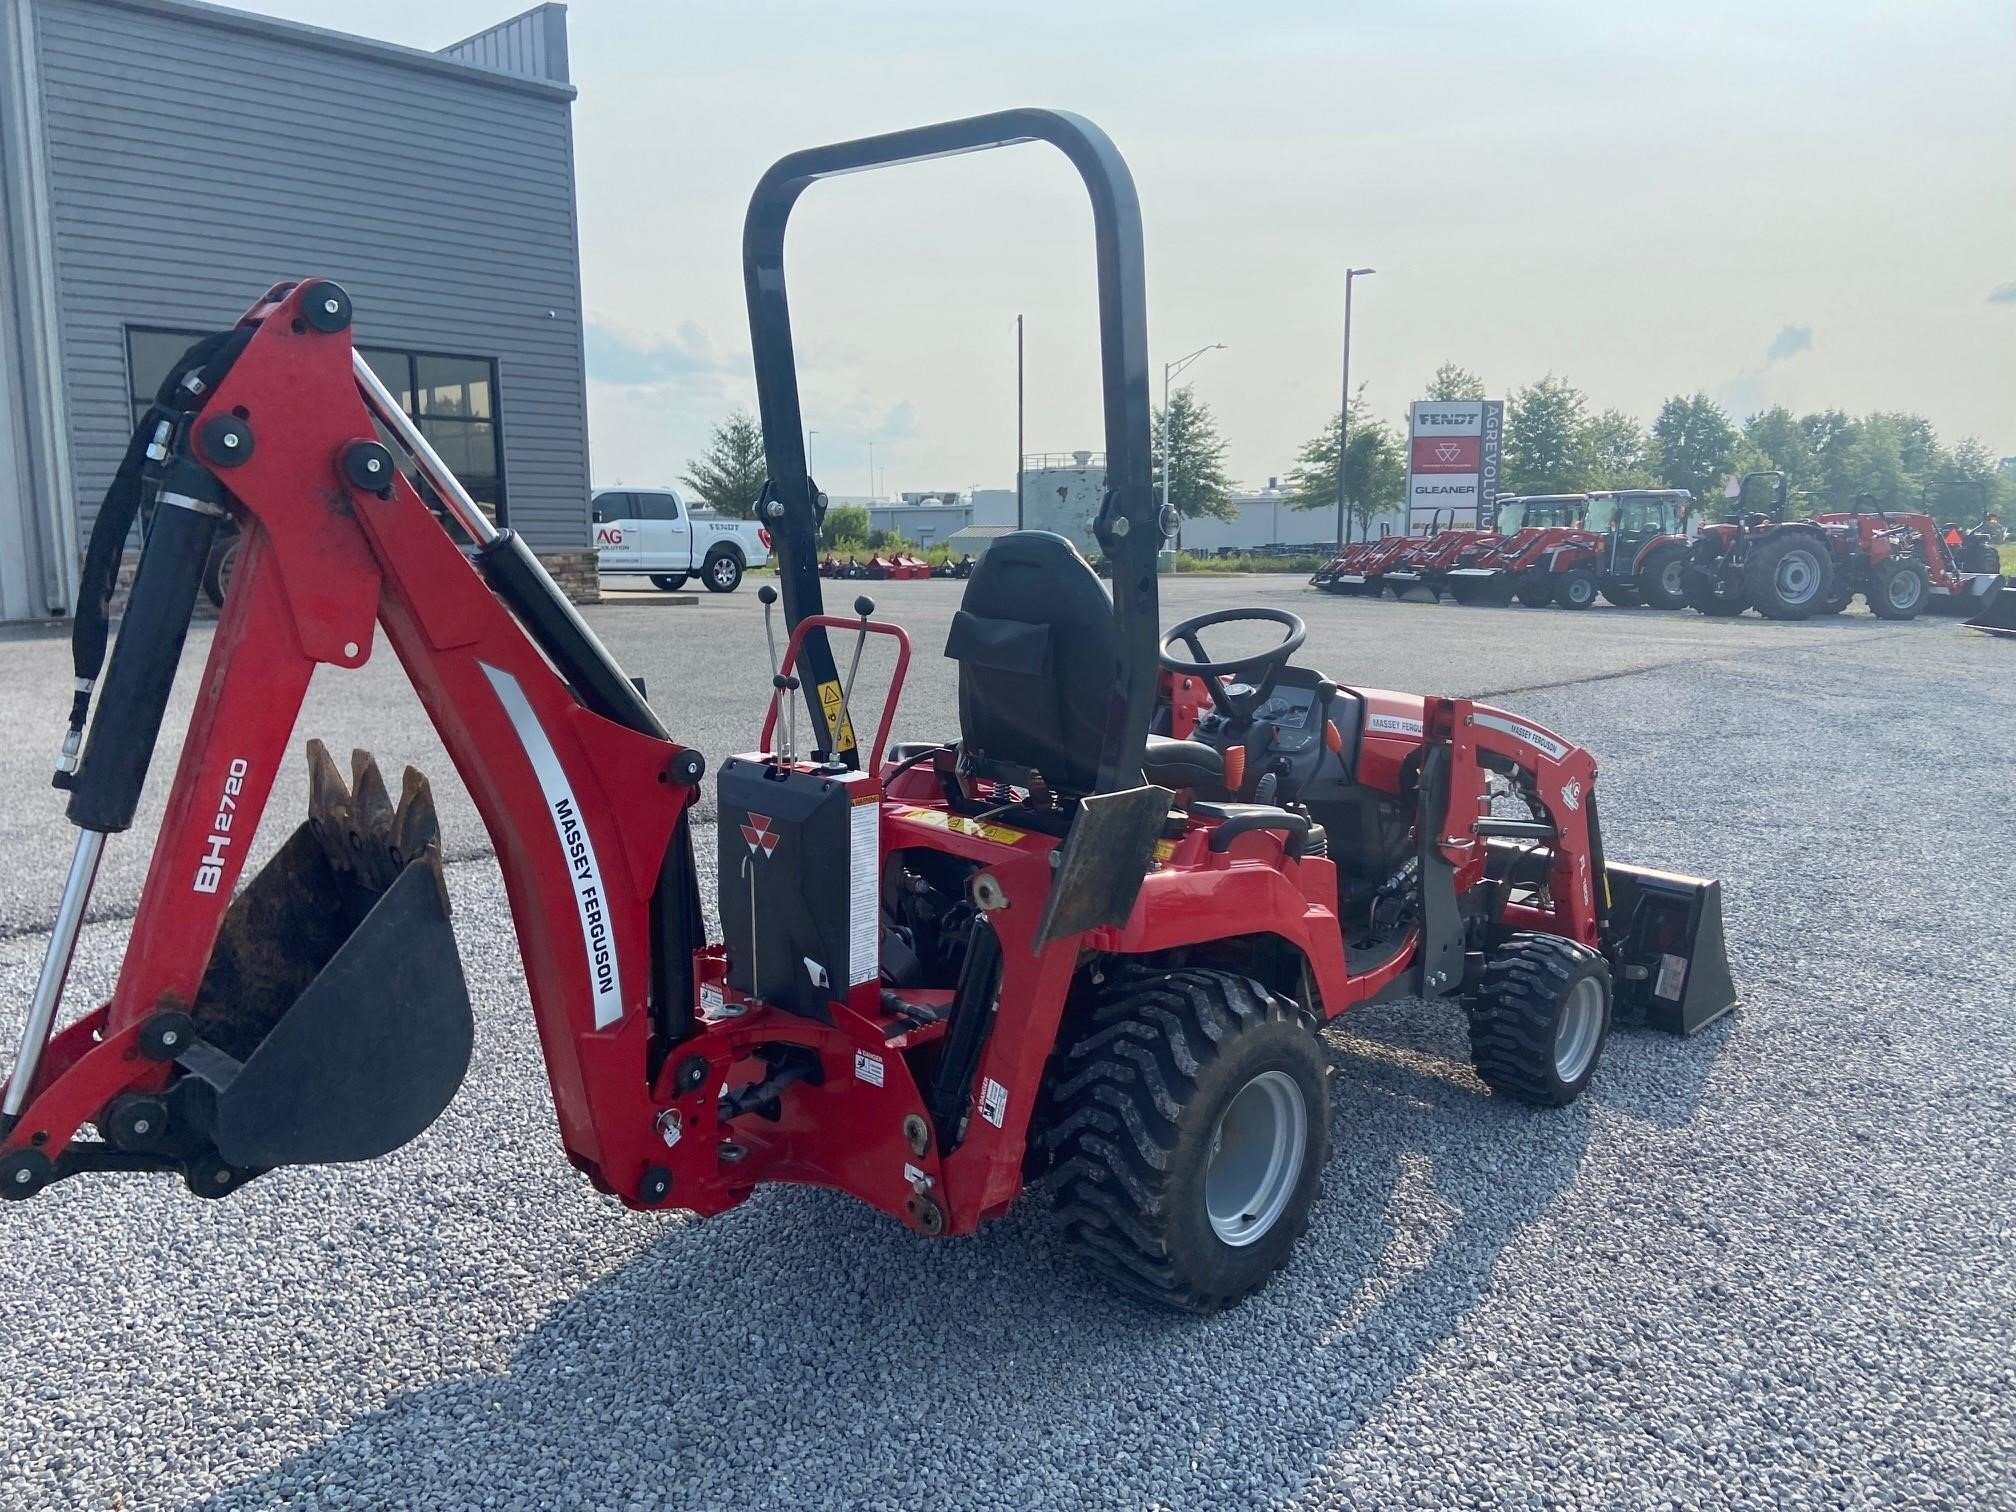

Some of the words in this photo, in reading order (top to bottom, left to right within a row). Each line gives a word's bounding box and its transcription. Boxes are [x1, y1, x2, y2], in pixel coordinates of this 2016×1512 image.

[1419, 413, 1479, 425] FENDT
[1415, 486, 1475, 494] GLEANER
[596, 528, 622, 545] AG
[1372, 718, 1400, 730] MASSEY
[1402, 722, 1424, 733] FERGU
[1510, 724, 1532, 740] MASSEY
[1531, 732, 1558, 754] FERGUSON
[192, 758, 248, 894] BH2720
[555, 798, 593, 880] MASSEY
[581, 886, 614, 995] FERGUSON
